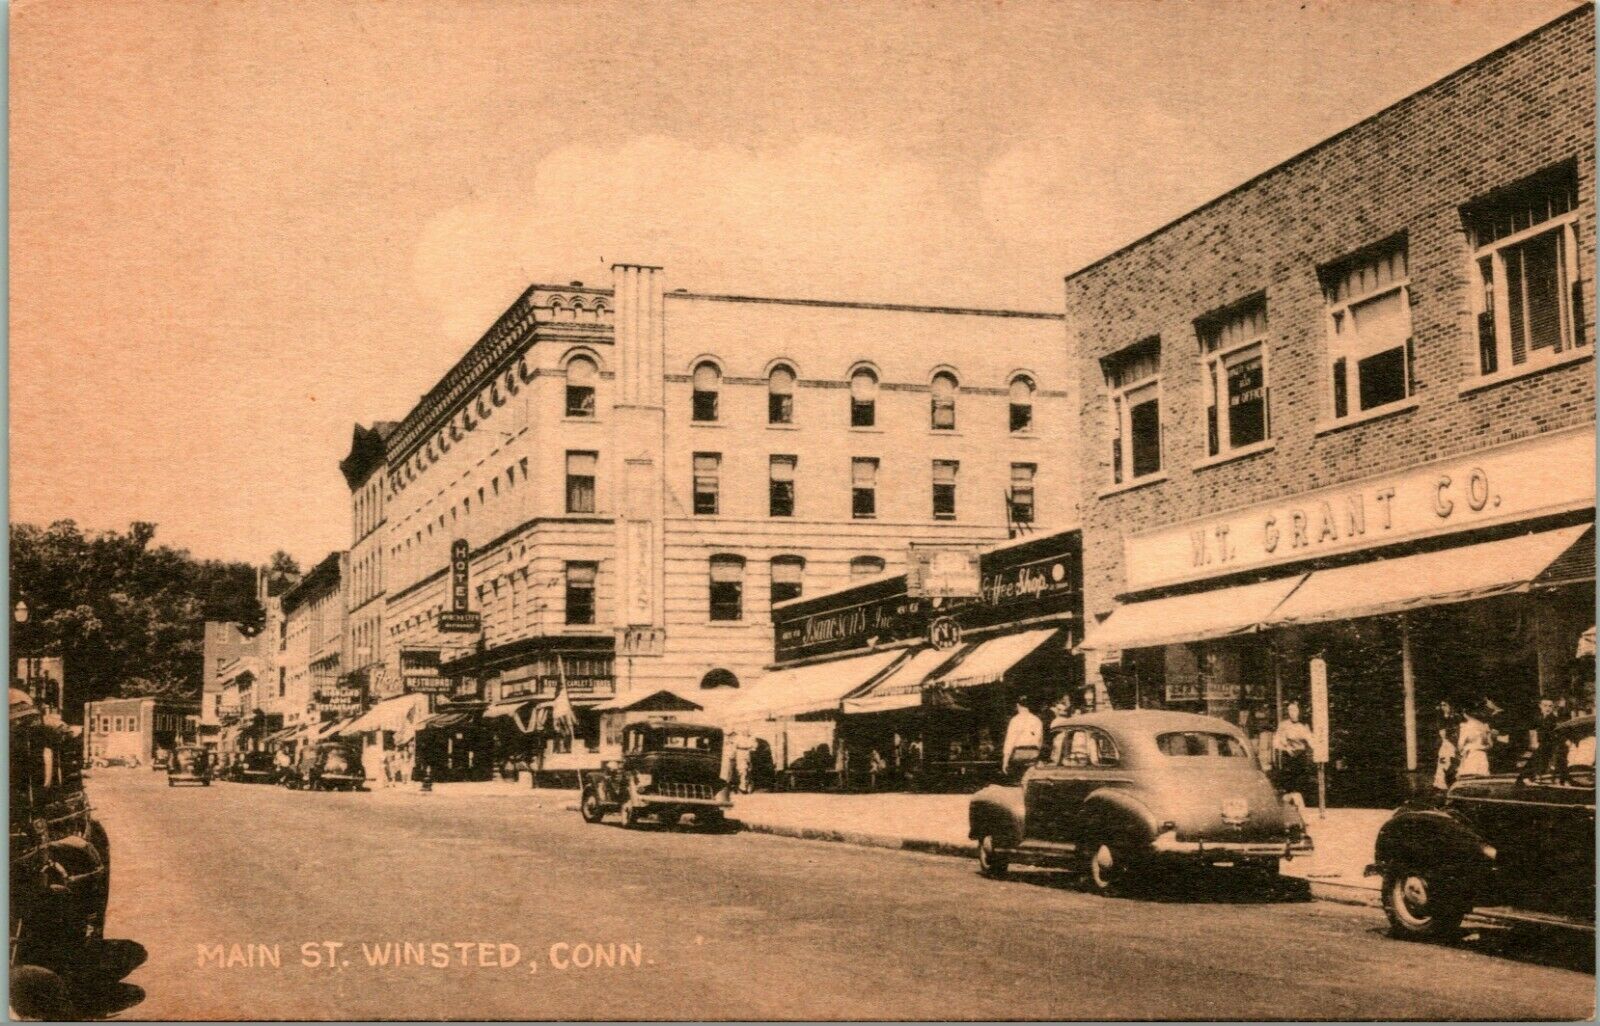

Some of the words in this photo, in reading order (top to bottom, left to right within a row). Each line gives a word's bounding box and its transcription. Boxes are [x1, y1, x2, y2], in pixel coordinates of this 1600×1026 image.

[1264, 487, 1396, 553] GRANT
[1434, 467, 1501, 518] CO.
[455, 547, 466, 609] HOTEL
[1016, 568, 1049, 599] Shop
